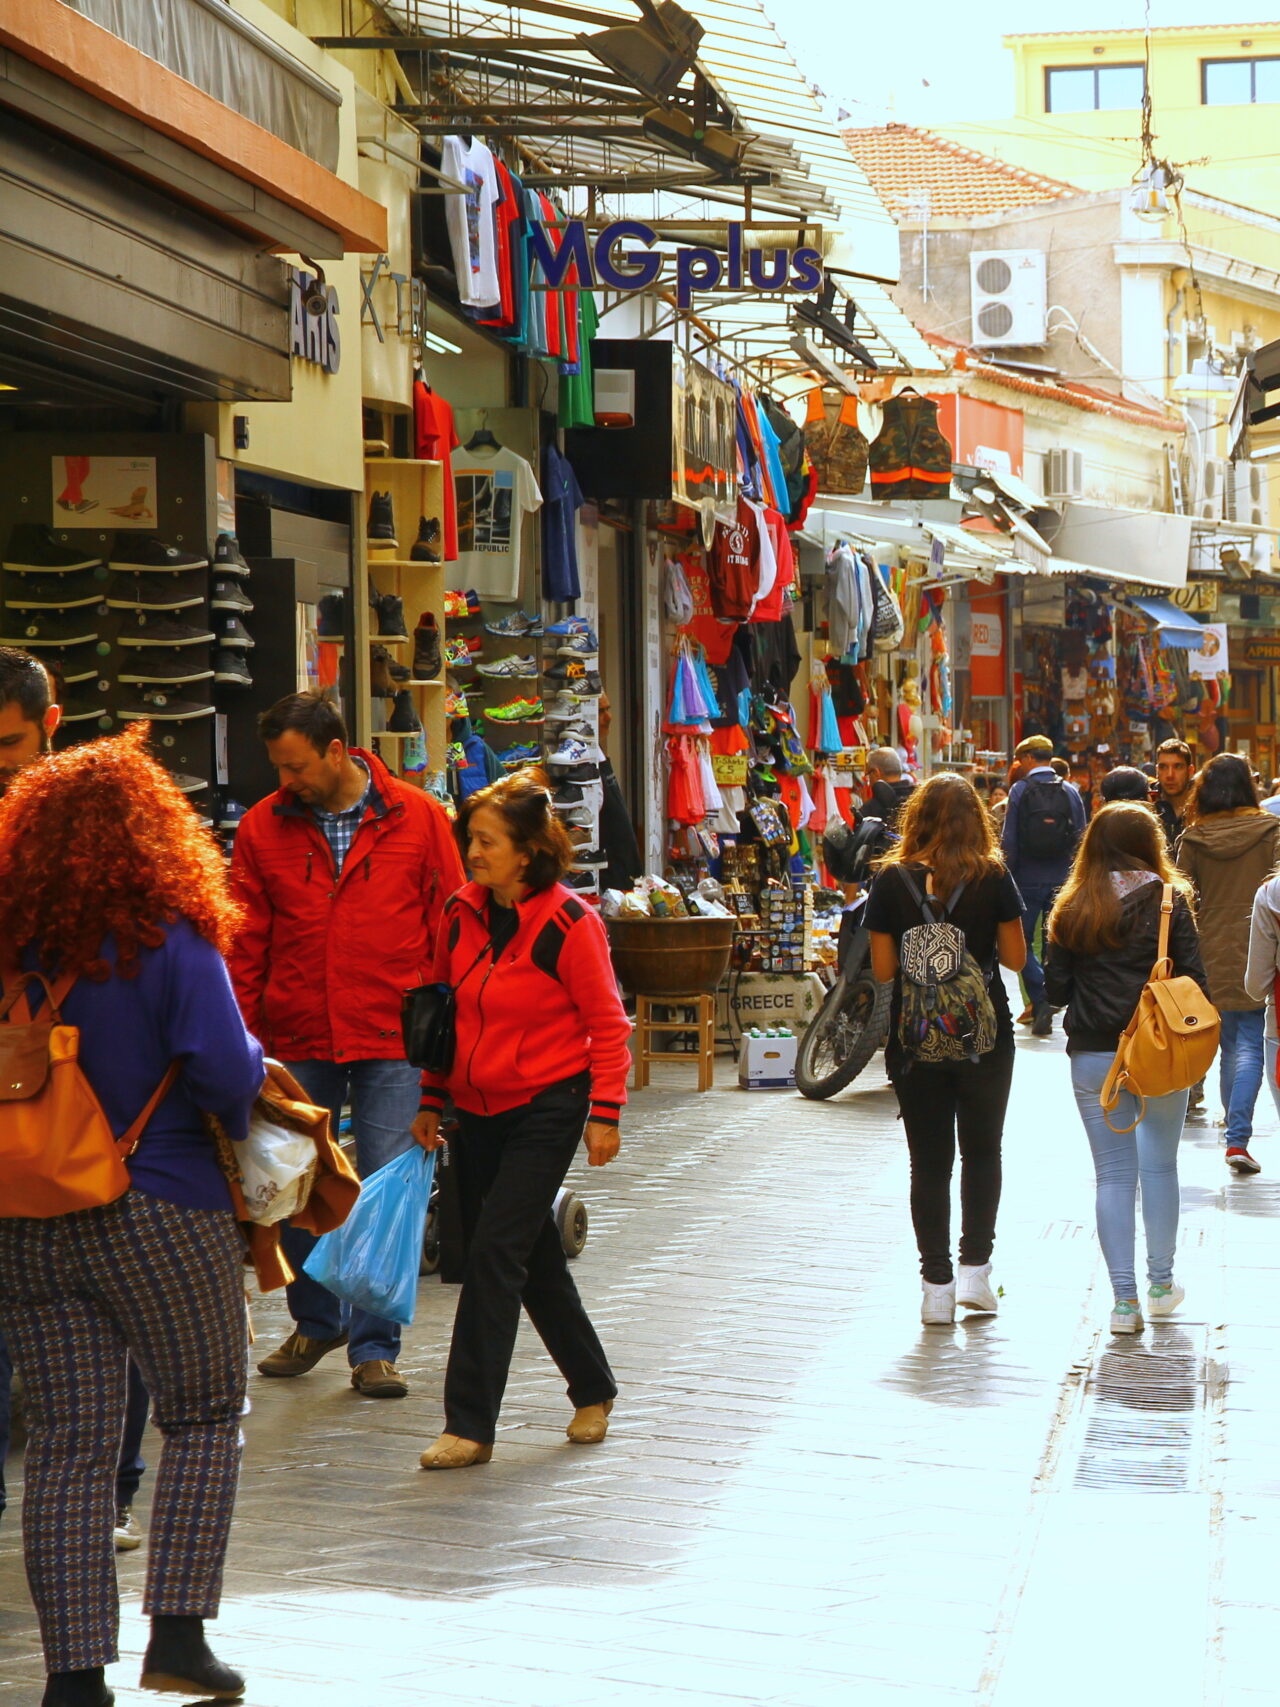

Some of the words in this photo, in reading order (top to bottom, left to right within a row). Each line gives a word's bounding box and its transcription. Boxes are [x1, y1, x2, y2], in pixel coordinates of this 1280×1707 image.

[528, 219, 663, 290] MG
[676, 220, 824, 310] plus
[730, 993, 795, 1010] GREECE
